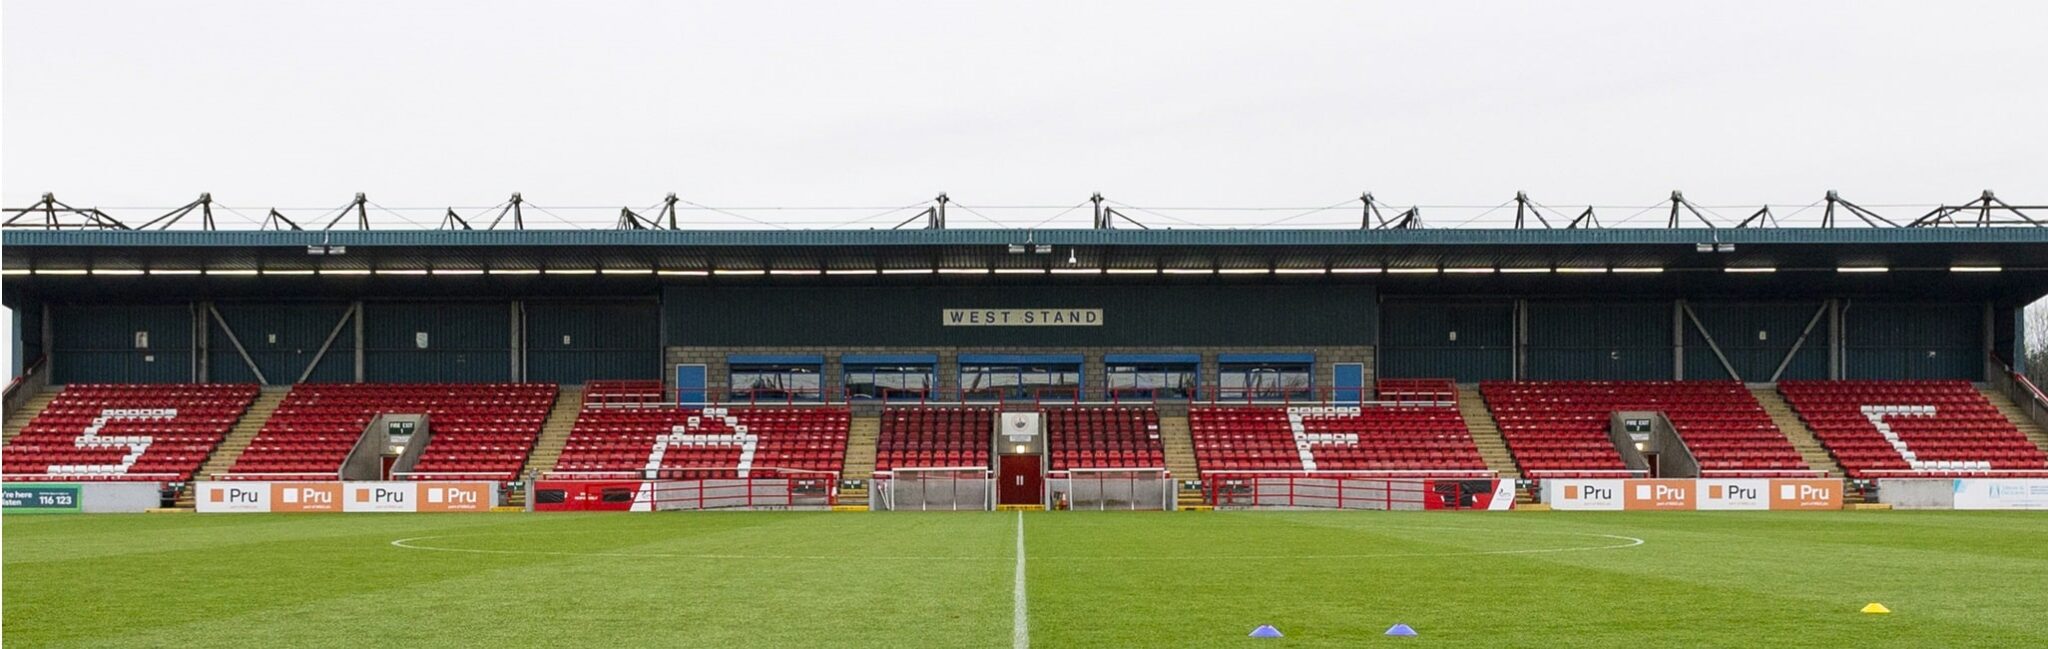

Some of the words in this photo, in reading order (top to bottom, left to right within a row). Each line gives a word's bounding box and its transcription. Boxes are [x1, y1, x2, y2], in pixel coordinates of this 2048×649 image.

[950, 311, 1011, 323] WEST
[1024, 311, 1097, 323] STAND
[47, 408, 177, 475] S
[644, 407, 758, 478] A
[1288, 406, 1361, 472] F
[1860, 405, 1990, 473] C
[230, 488, 258, 503] Pru
[303, 488, 332, 503] Pru
[375, 488, 403, 503] Pru
[447, 488, 476, 503] Pru
[1584, 485, 1612, 500] Pru
[1656, 485, 1685, 500] Pru
[1728, 485, 1756, 500] Pru
[1800, 485, 1829, 500] Pru
[39, 496, 54, 505] 116
[56, 496, 72, 505] 123
